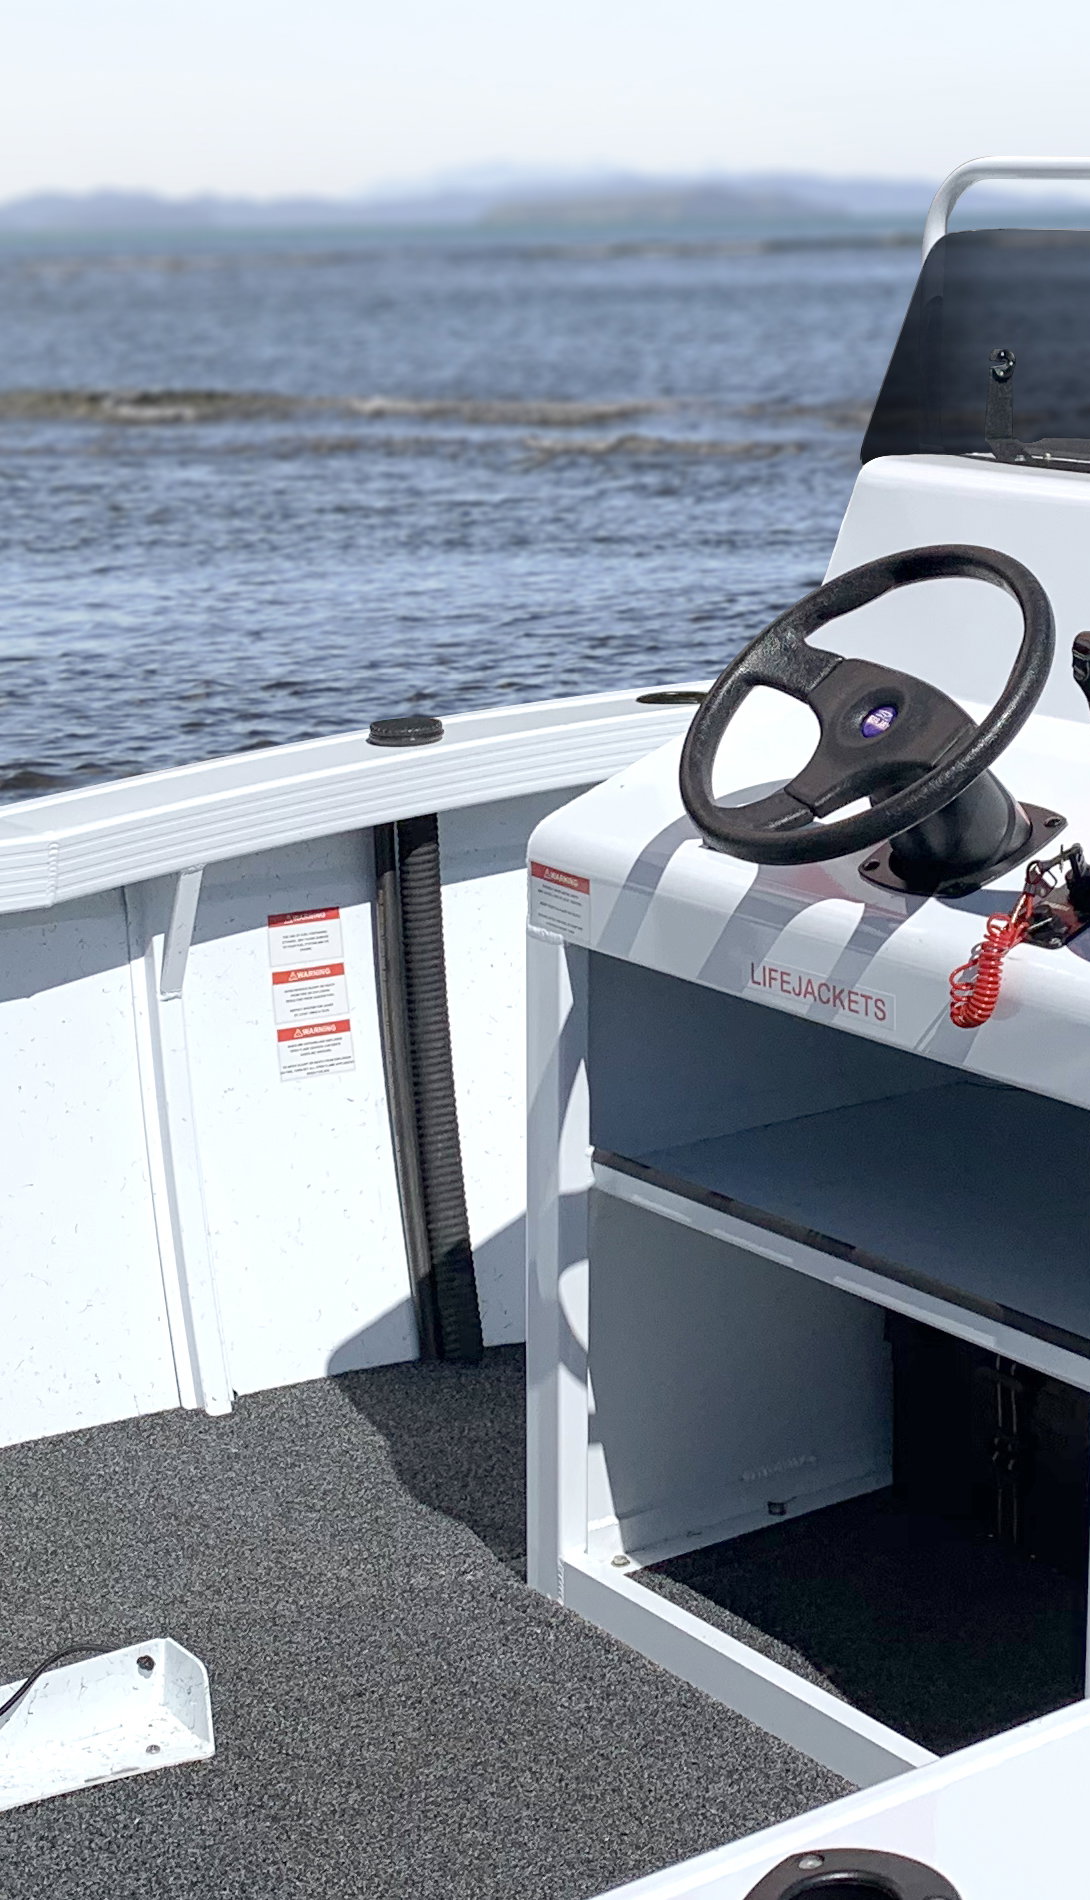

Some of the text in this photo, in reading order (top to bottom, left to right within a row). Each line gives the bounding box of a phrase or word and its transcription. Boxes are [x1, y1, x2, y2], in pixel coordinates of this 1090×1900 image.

[549, 871, 579, 888] WARNING
[296, 967, 332, 979] WARNING
[750, 961, 887, 1022] LIFEJACKETS
[302, 1023, 337, 1035] WARNING
